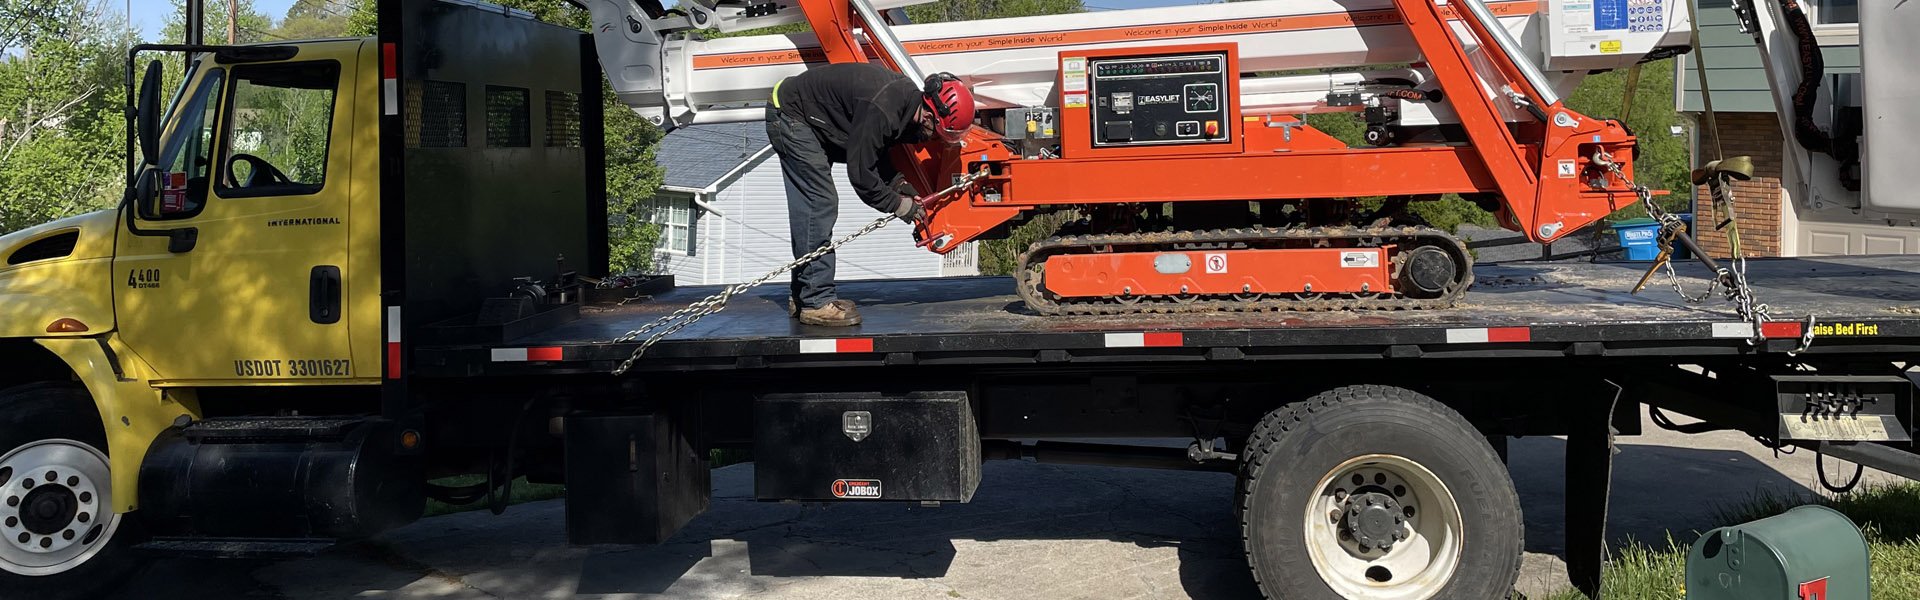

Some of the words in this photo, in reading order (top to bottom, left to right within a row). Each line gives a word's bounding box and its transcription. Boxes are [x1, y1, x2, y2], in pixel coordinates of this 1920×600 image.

[1124, 29, 1161, 37] Welcome
[1175, 26, 1194, 36] your
[1198, 24, 1224, 32] Simple
[1225, 22, 1248, 30] Inside
[918, 41, 954, 51] Welcome
[965, 40, 983, 51] your
[988, 37, 1013, 46] Simple
[1013, 35, 1035, 44] Inside
[721, 56, 755, 64] Welcome
[767, 53, 785, 63] your
[1145, 94, 1180, 102] EASYLIFT
[267, 217, 341, 227] INTERNATIONAL
[1835, 323, 1854, 335] Bed
[1856, 323, 1878, 335] First
[234, 359, 281, 377] USDOT
[288, 359, 350, 376] 3301627
[849, 486, 879, 496] JOBOX
